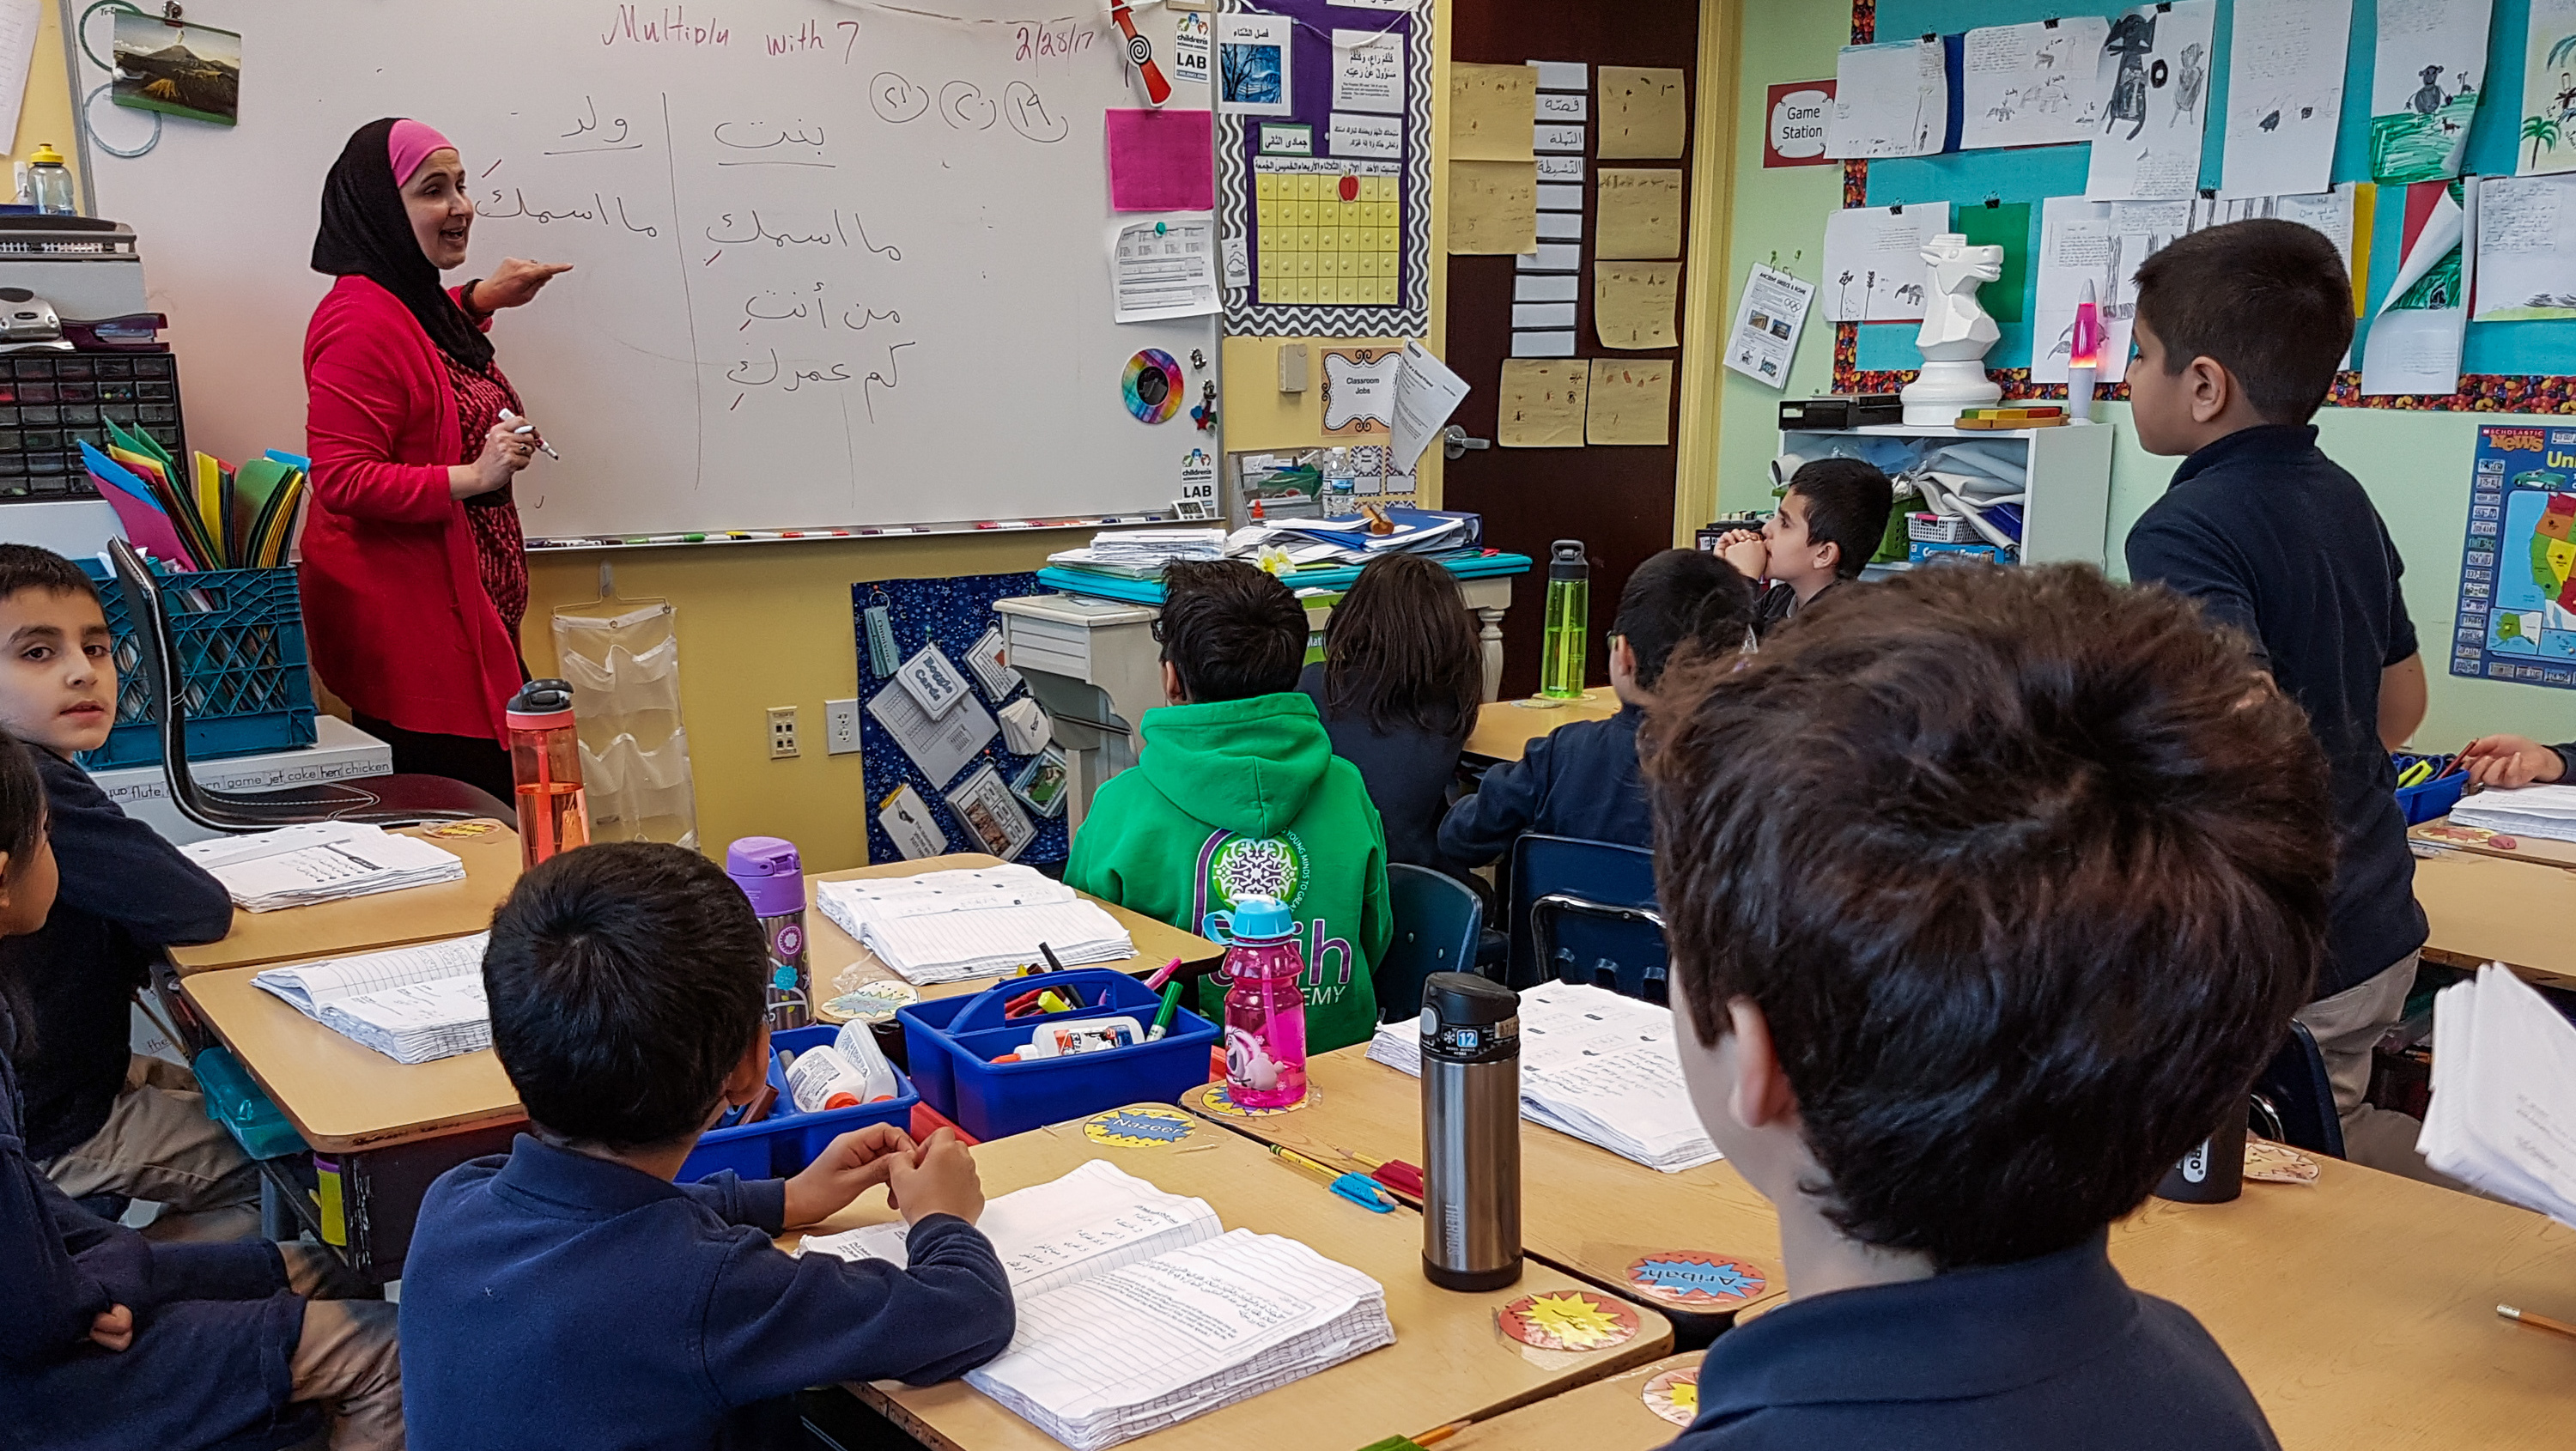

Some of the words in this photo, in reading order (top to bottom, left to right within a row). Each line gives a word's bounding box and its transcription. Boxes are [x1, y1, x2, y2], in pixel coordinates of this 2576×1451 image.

[766, 19, 824, 56] with
[837, 21, 859, 64] 7
[1016, 23, 1094, 77] 2/28/17
[1177, 52, 1206, 69] LAB
[560, 95, 628, 143] ولد
[1788, 106, 1820, 119] Game
[714, 118, 824, 155] بنت
[1782, 125, 1822, 139] Station
[844, 303, 901, 331] من
[1183, 485, 1212, 498] LAB
[227, 775, 262, 789] game
[267, 771, 283, 786] jet
[288, 765, 316, 781] cake
[345, 762, 390, 774] chicken
[131, 784, 161, 799] flute
[1286, 829, 1306, 856] YOUNG
[1301, 854, 1310, 879] MINDS
[1299, 879, 1309, 891] TO
[1459, 1032, 1475, 1046] 12
[1113, 1118, 1184, 1135] Nazeer
[1648, 1269, 1737, 1286] Aribah
